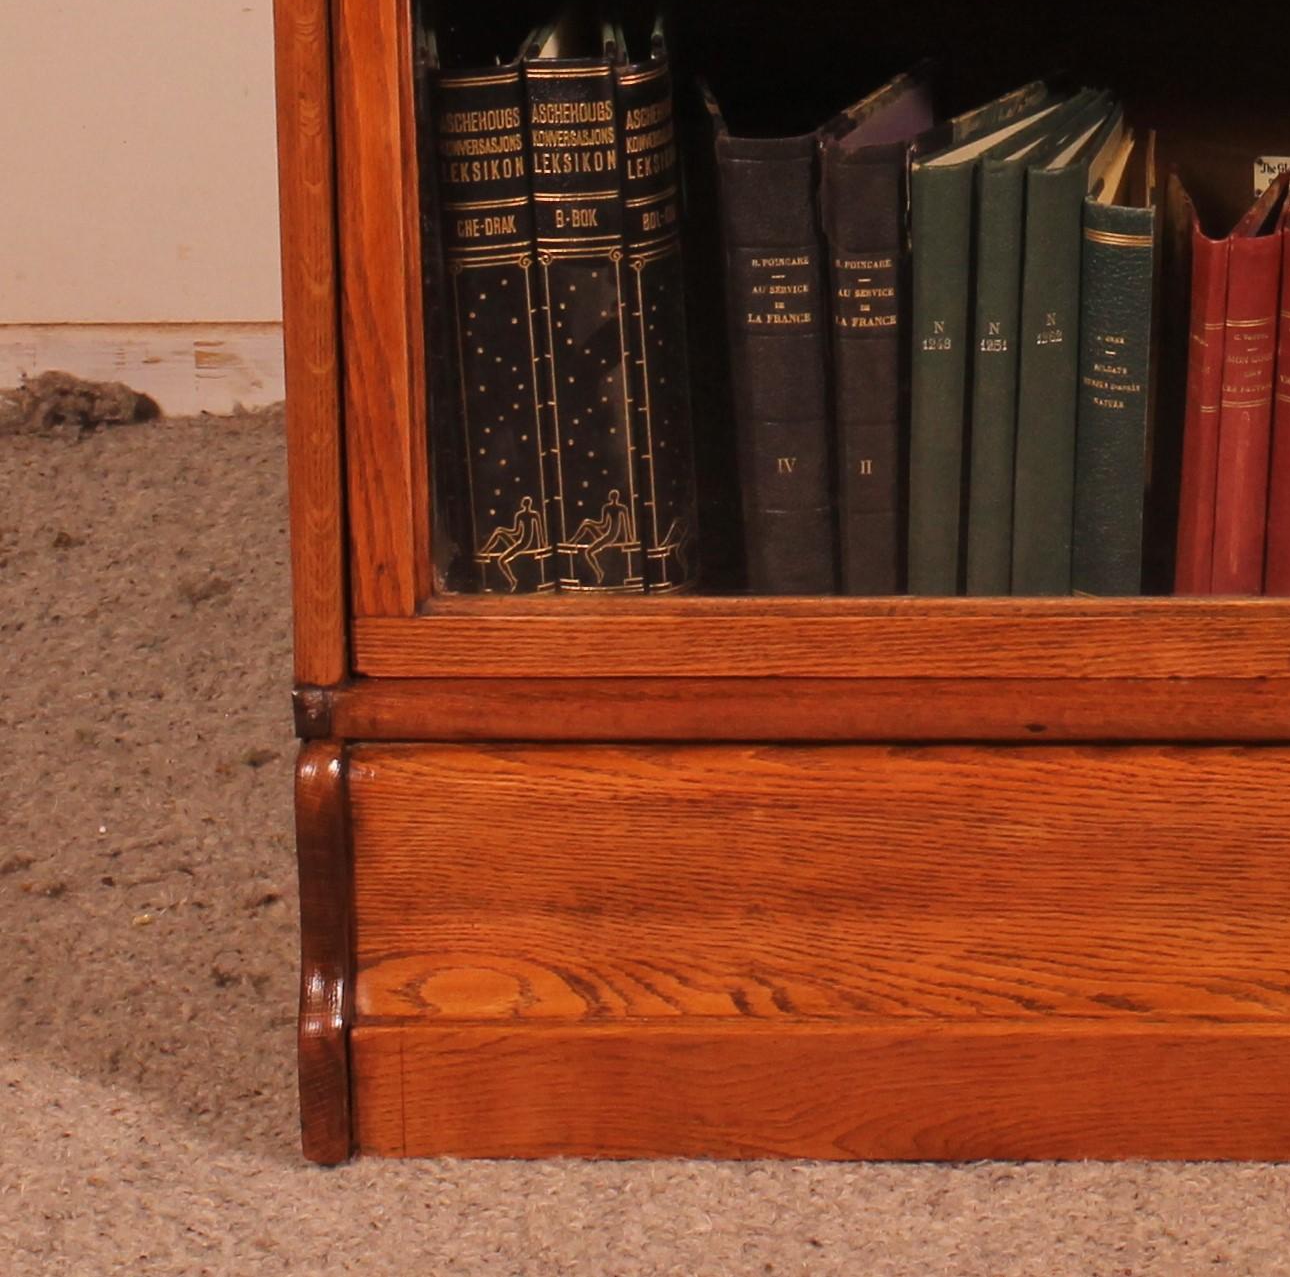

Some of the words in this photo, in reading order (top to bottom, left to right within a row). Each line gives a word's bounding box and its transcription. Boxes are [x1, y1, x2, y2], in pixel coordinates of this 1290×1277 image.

[531, 100, 614, 124] ASCHEHOUGS
[532, 127, 615, 147] KONVERSASJONS
[442, 156, 525, 182] EKSIKON
[534, 150, 617, 174] LEKSIKON
[1260, 162, 1276, 174] The
[457, 214, 517, 238] CHE-DRAK
[752, 286, 765, 294] AU
[770, 284, 809, 294] SERVICE
[838, 289, 850, 297] AU
[854, 288, 894, 298] SERVICE
[748, 313, 762, 323] LA
[767, 312, 811, 324] FRANCE
[851, 314, 897, 328] FRANCE
[1046, 312, 1056, 326] N
[934, 320, 945, 334] N
[988, 322, 1001, 336] N
[777, 457, 797, 474] IV
[860, 460, 872, 474] II
